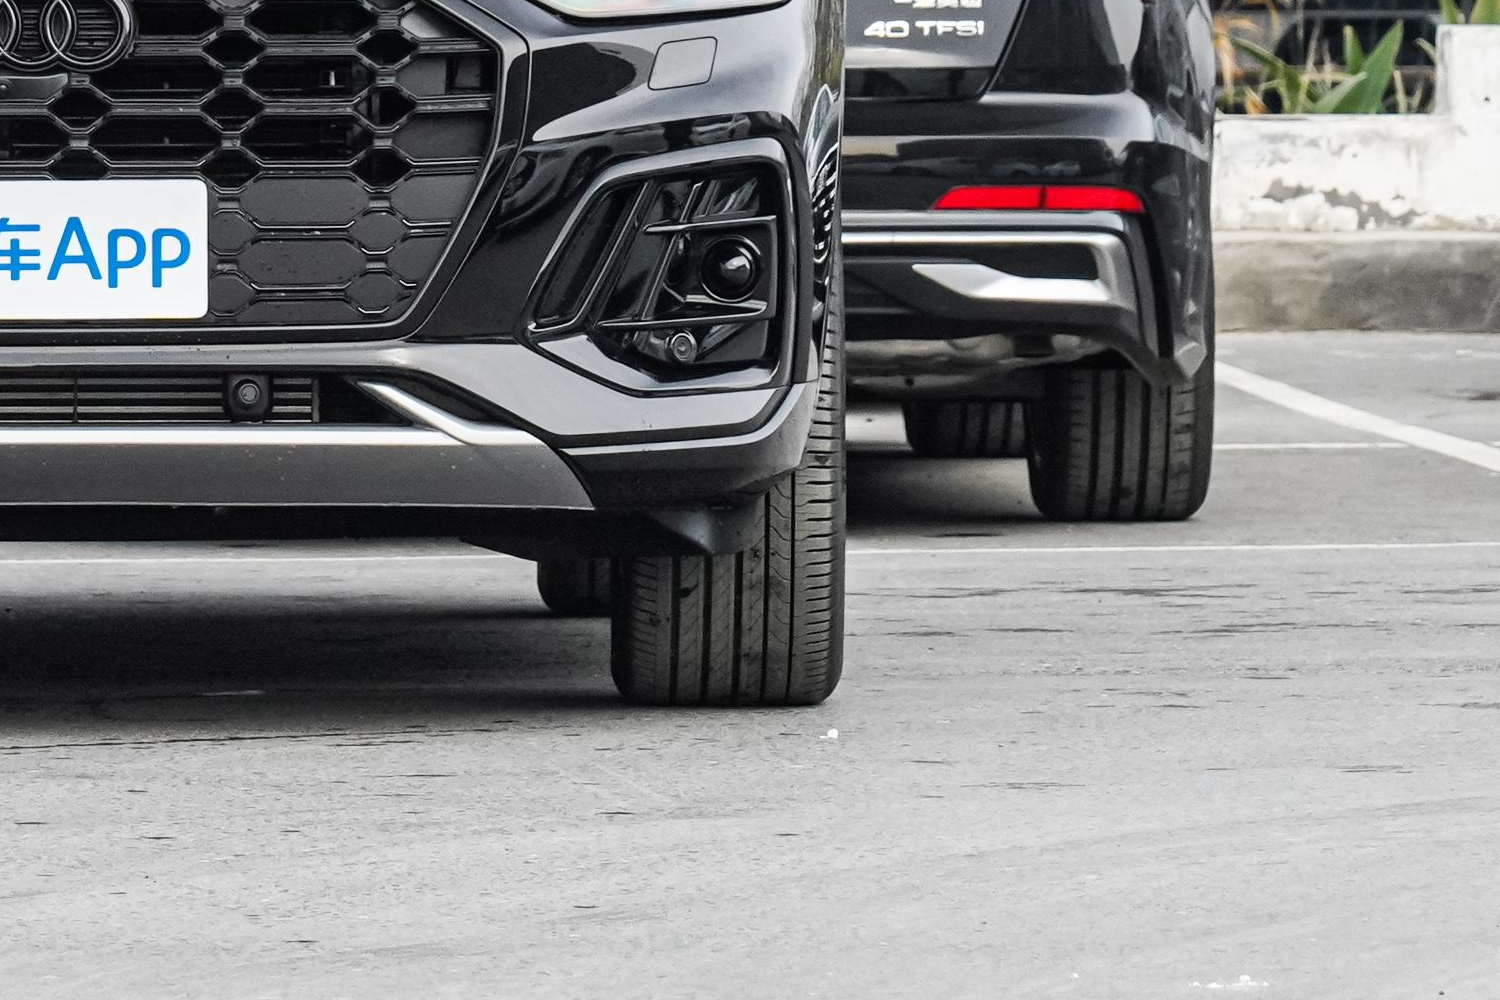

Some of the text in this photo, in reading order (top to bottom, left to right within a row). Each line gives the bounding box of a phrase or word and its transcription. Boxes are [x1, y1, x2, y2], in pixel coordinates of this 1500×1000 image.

[864, 20, 985, 38] 40 TFSI
[47, 216, 191, 288] App
